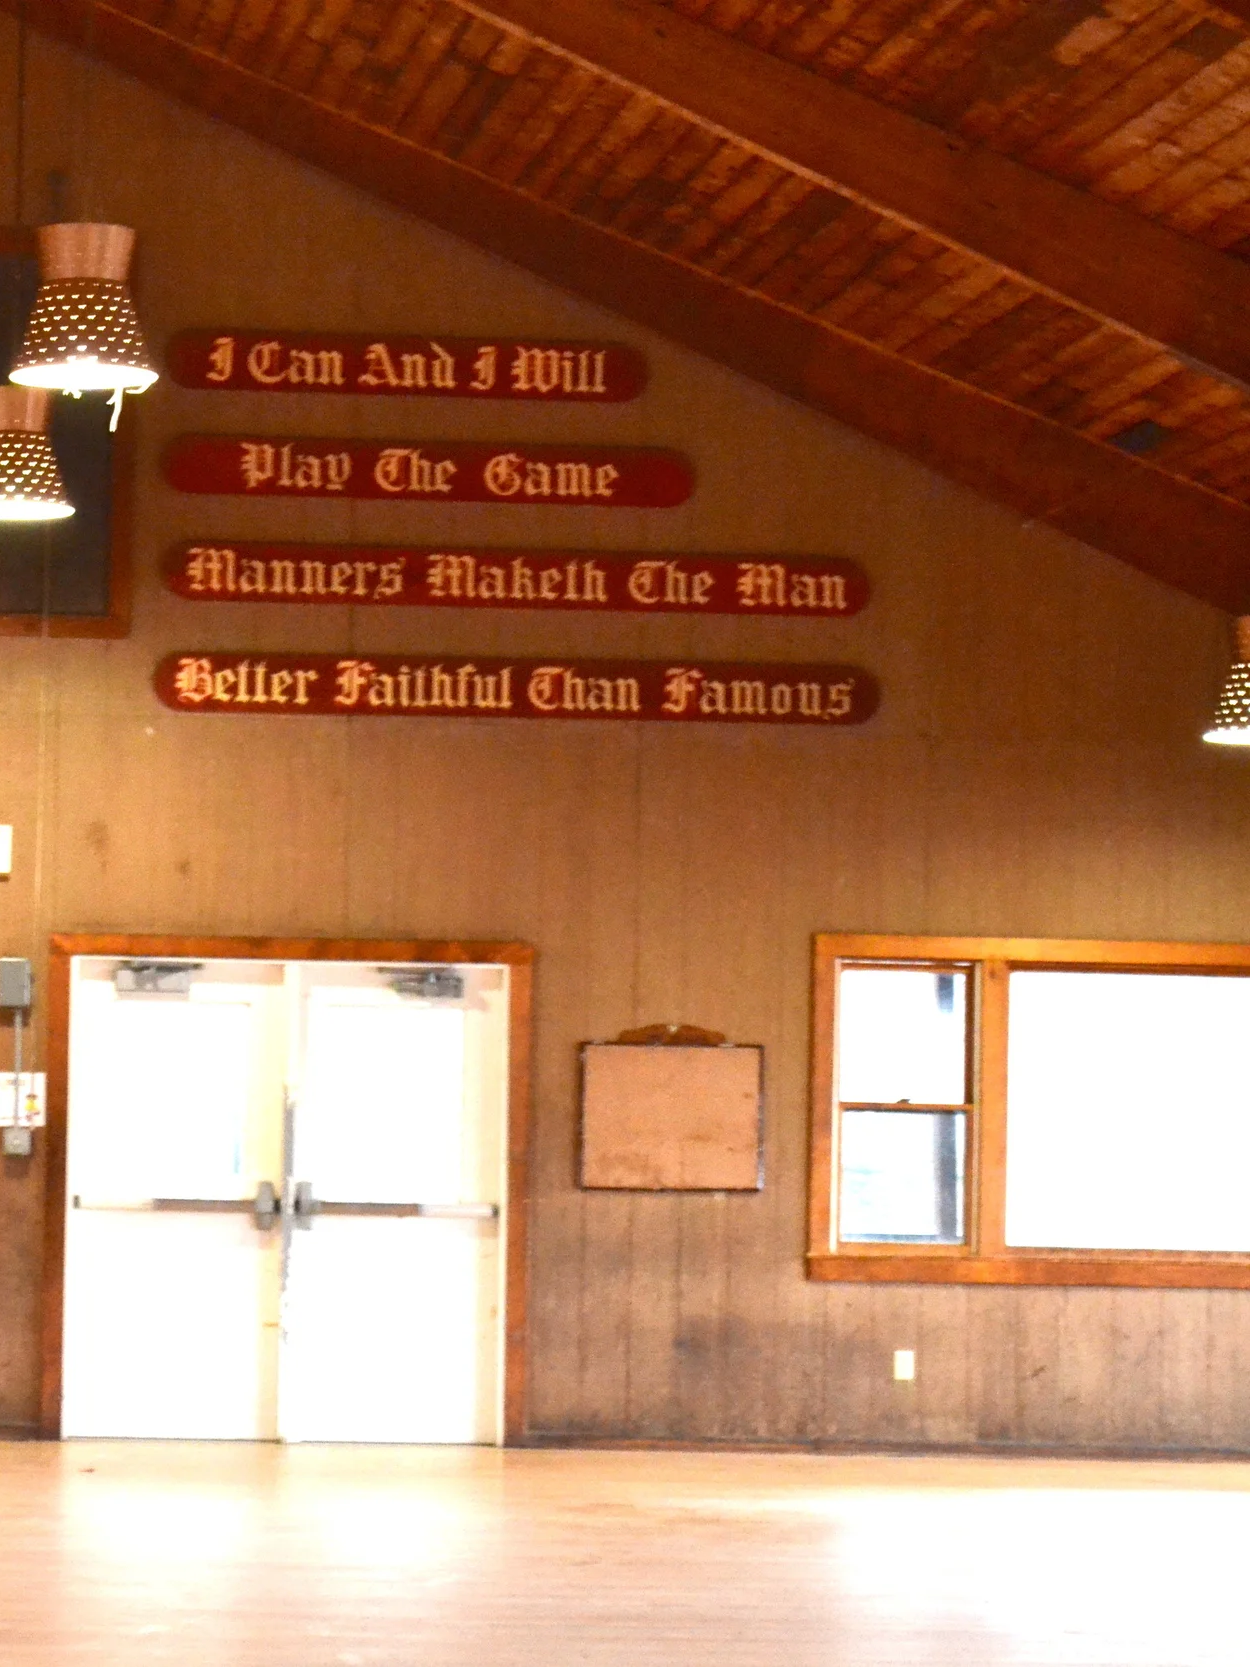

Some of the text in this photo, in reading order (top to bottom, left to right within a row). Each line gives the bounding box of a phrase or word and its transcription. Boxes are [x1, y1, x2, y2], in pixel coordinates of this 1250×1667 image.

[208, 338, 608, 394] I Can And I Will
[240, 442, 618, 498] Play The Game
[186, 548, 846, 609] Manners Maketh The Man
[175, 659, 854, 720] Better Faithful Than Famous
